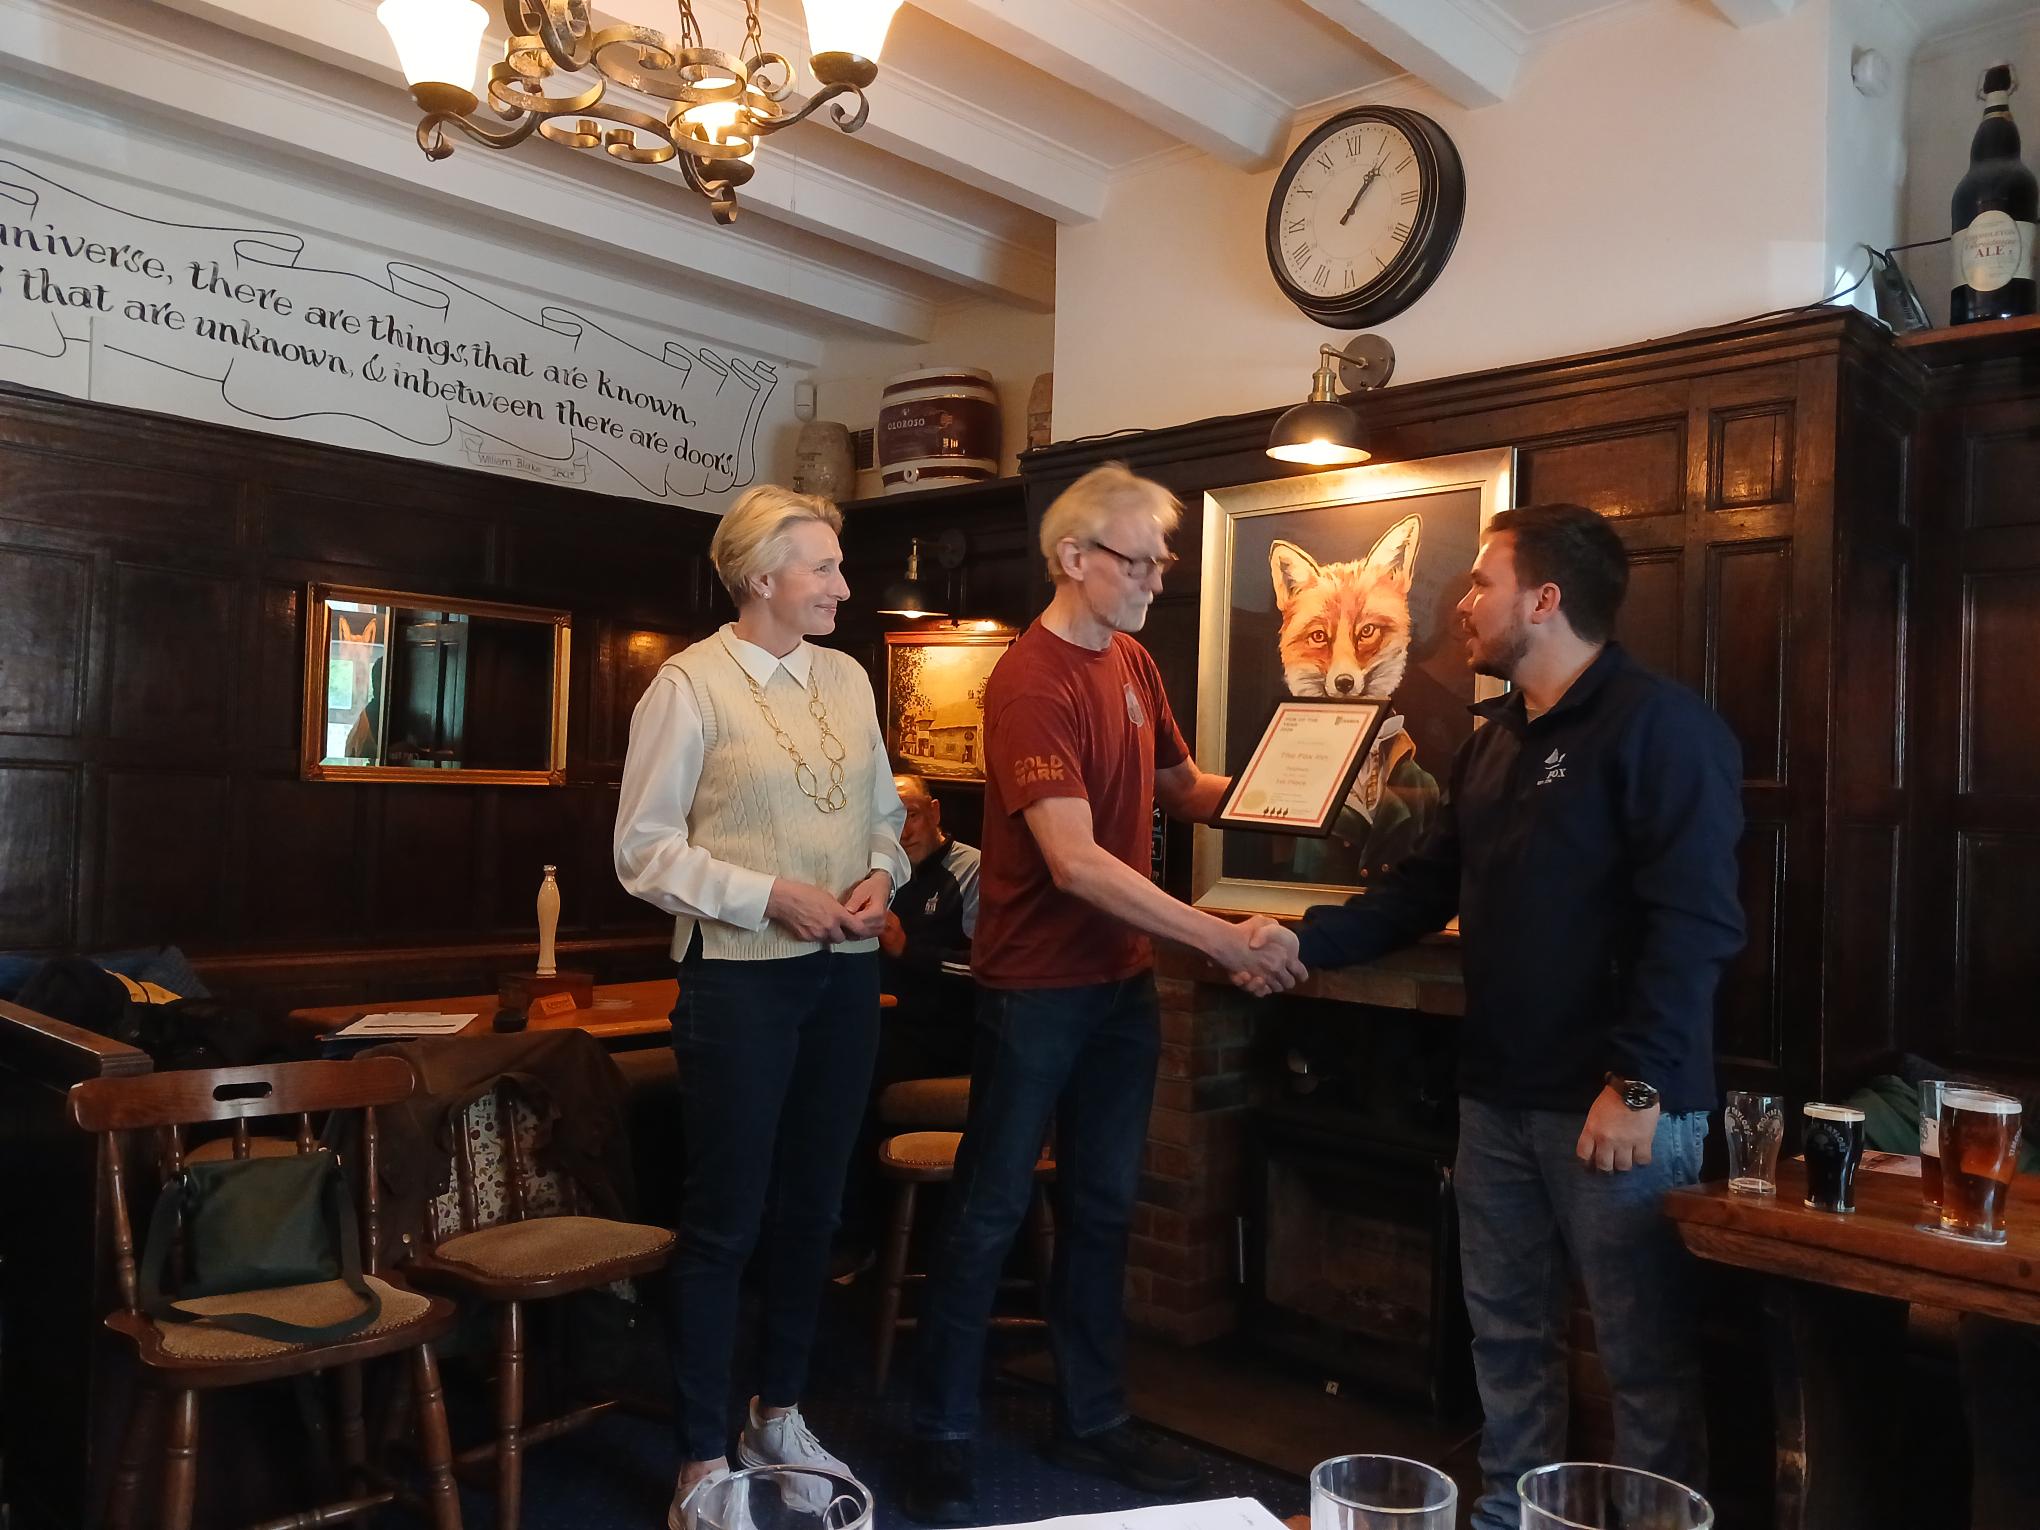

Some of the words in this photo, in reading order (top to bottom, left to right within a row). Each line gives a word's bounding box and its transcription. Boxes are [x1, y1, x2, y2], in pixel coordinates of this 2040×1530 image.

[17, 267, 114, 313] that
[124, 300, 187, 331] are
[194, 315, 354, 378] unknown,
[362, 353, 387, 383] &
[393, 362, 544, 421] inbetween
[555, 400, 624, 439] there
[629, 429, 669, 454] are
[187, 259, 293, 316] there
[304, 306, 361, 335] are
[471, 340, 535, 378] that
[543, 366, 589, 390] are
[597, 369, 697, 428] known,
[481, 454, 512, 467] William
